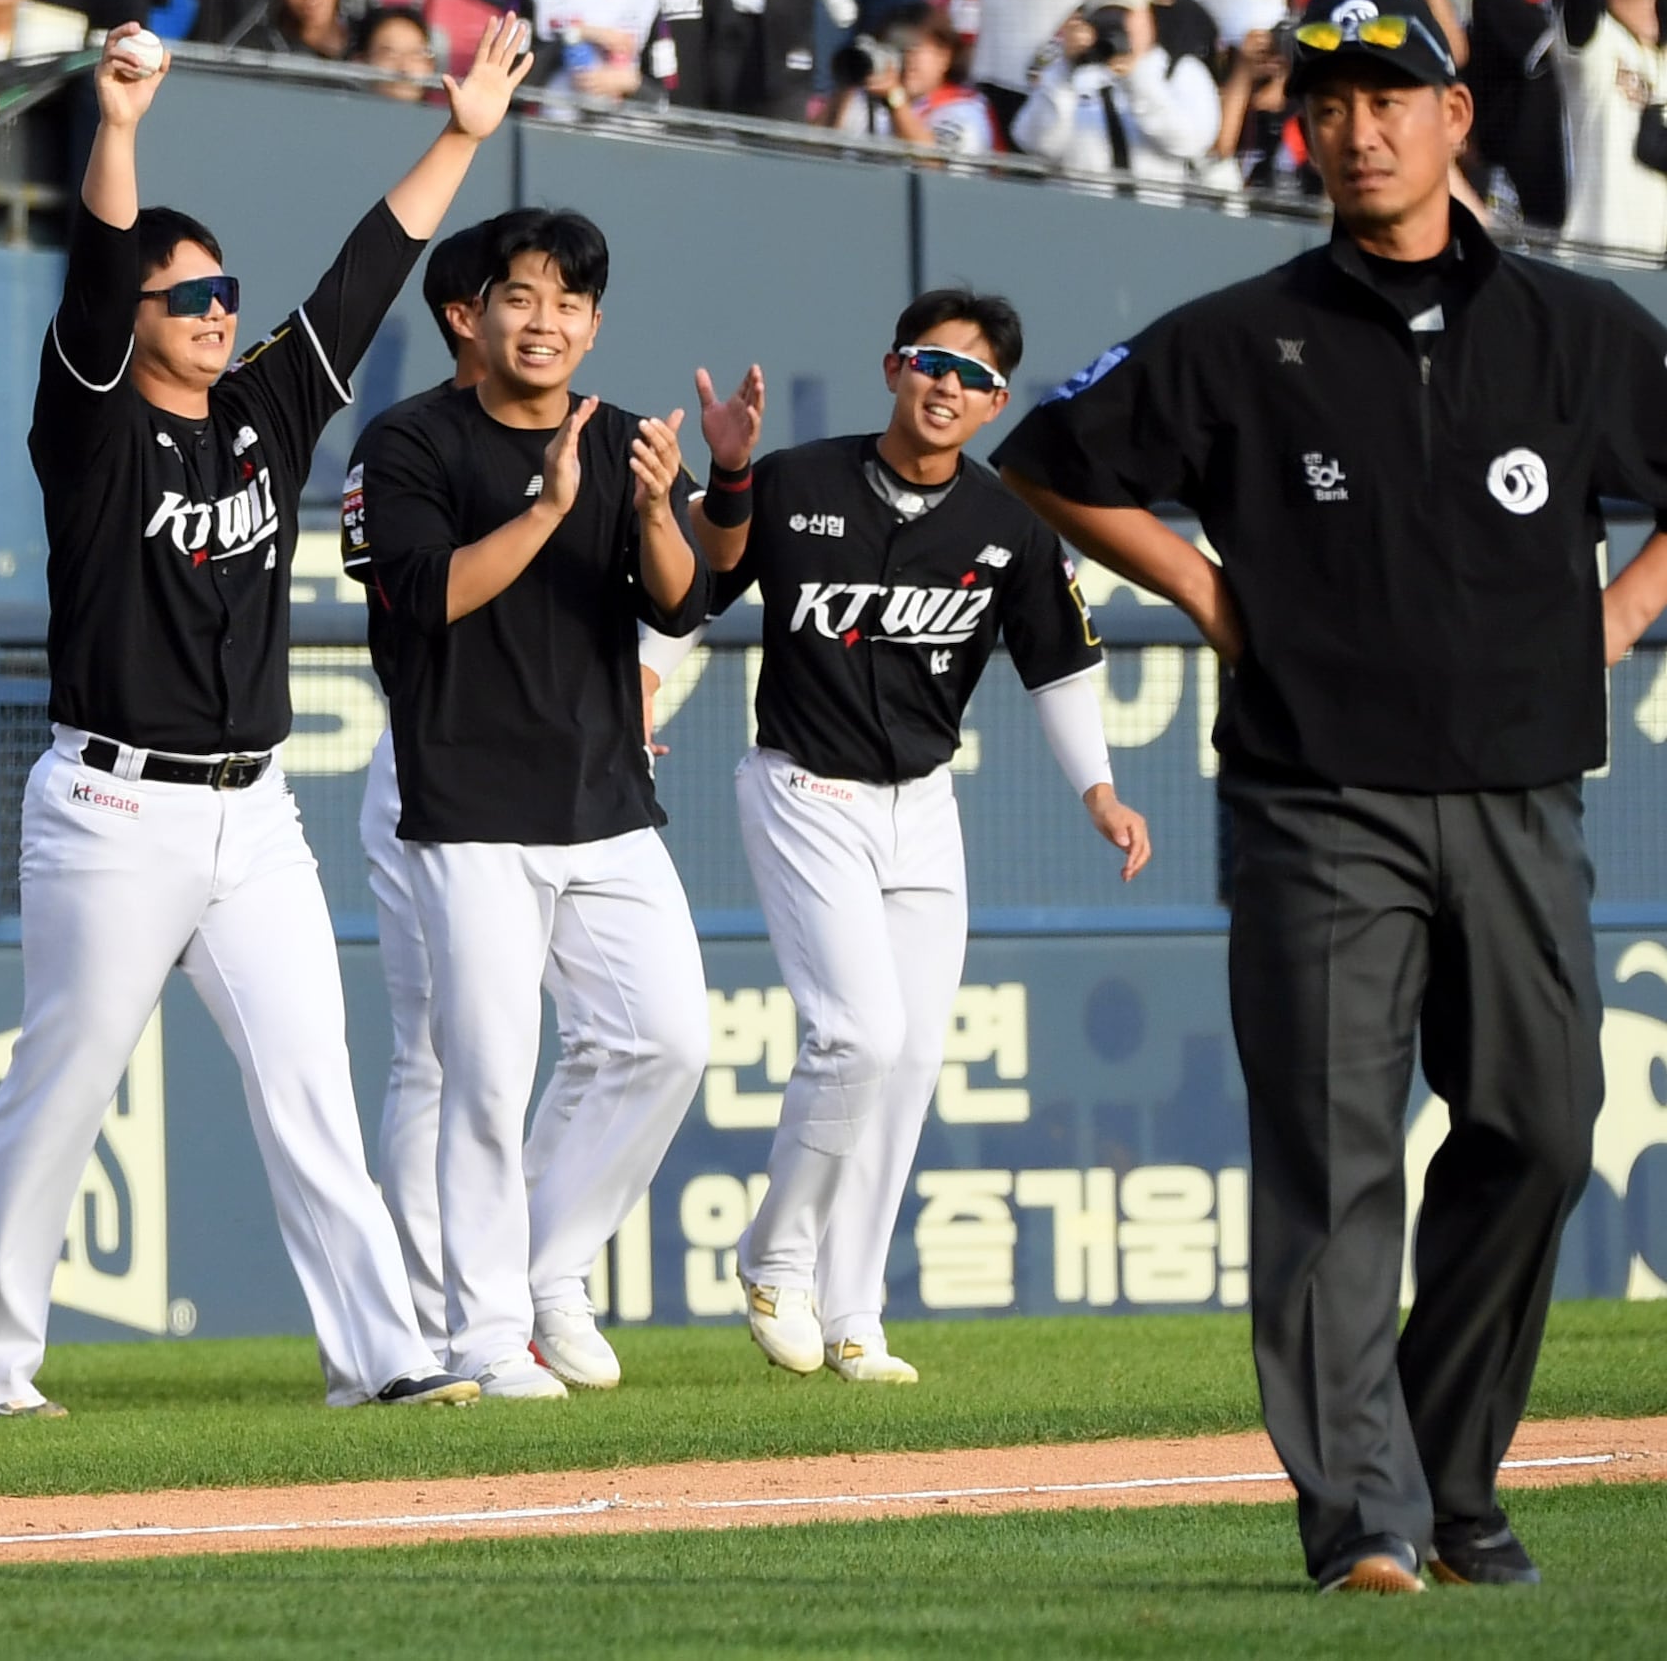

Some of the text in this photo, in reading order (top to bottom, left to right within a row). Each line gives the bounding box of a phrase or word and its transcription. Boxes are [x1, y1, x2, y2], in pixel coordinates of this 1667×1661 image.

[1314, 488, 1349, 502] Bank
[808, 513, 845, 538] 신협
[789, 582, 889, 640] KT
[929, 648, 953, 676] kt
[72, 781, 140, 814] kt estate
[789, 771, 854, 803] kt estate
[914, 1164, 1251, 1310] 즐거움!
